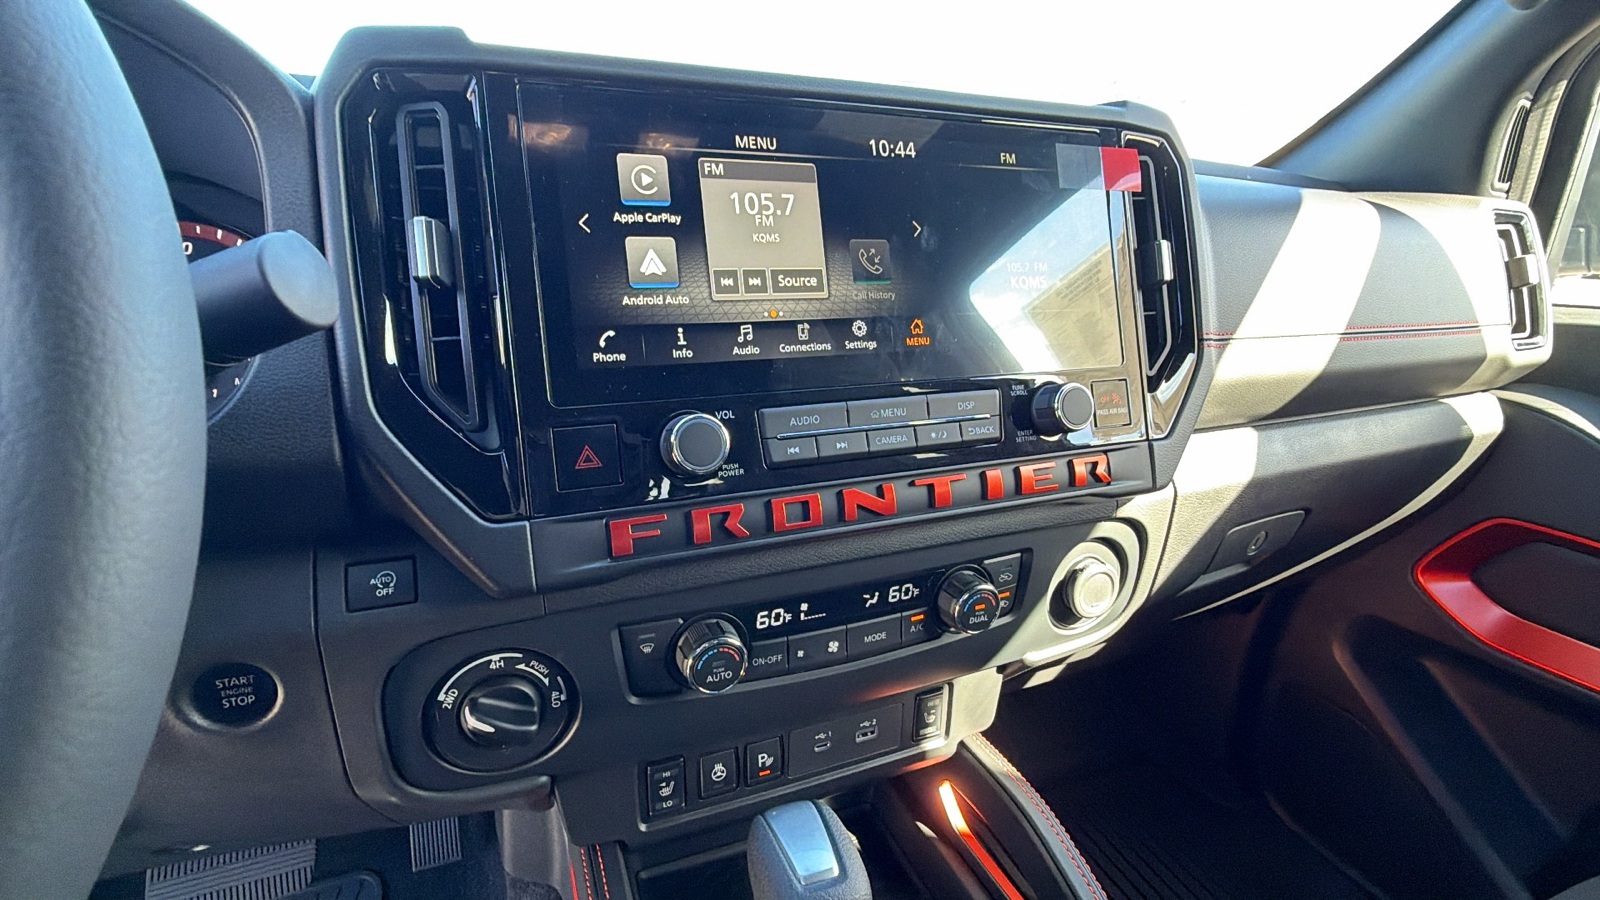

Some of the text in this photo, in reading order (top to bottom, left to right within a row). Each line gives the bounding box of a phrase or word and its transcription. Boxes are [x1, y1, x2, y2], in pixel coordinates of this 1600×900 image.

[735, 135, 777, 150] MENU
[868, 139, 917, 159] 10:44
[1000, 152, 1016, 164] FM
[704, 163, 724, 176] FM
[729, 192, 795, 216] 105.7
[613, 212, 681, 225] Apple CarPlay
[755, 215, 774, 227] FM
[752, 233, 780, 244] KQMS
[1006, 262, 1048, 273] 105.7 FM
[778, 274, 818, 287] Source
[1010, 276, 1047, 289] KQMS
[622, 295, 689, 306] Android Auto
[852, 291, 896, 301] Call History
[845, 340, 877, 351] Settings
[906, 336, 930, 346] MENU
[732, 345, 760, 356] Audio
[779, 342, 832, 353] Connections
[593, 352, 626, 363] Phone
[672, 349, 693, 359] Info
[957, 401, 975, 411] DISP
[715, 410, 735, 420] VOL
[880, 407, 907, 418] MENU
[790, 415, 821, 426] AUDIO
[975, 426, 995, 435] BACK
[875, 434, 908, 445] CAMERA
[718, 468, 745, 478] POWER
[608, 452, 1112, 557] FRONTIER
[370, 575, 392, 586] AUTO
[376, 587, 395, 597] OFF
[969, 615, 988, 624] DUAL
[910, 622, 924, 633] A/C
[864, 631, 887, 644] MODE
[489, 659, 504, 670] 4H
[752, 654, 783, 667] ON-OFF
[529, 660, 550, 675] PUSH
[215, 674, 255, 689] START
[706, 670, 733, 683] AUTO
[221, 686, 254, 697] ENGINE
[222, 694, 256, 709] STOP
[442, 688, 459, 710] 2WD
[551, 690, 561, 708] 4LO
[662, 800, 673, 808] LO
